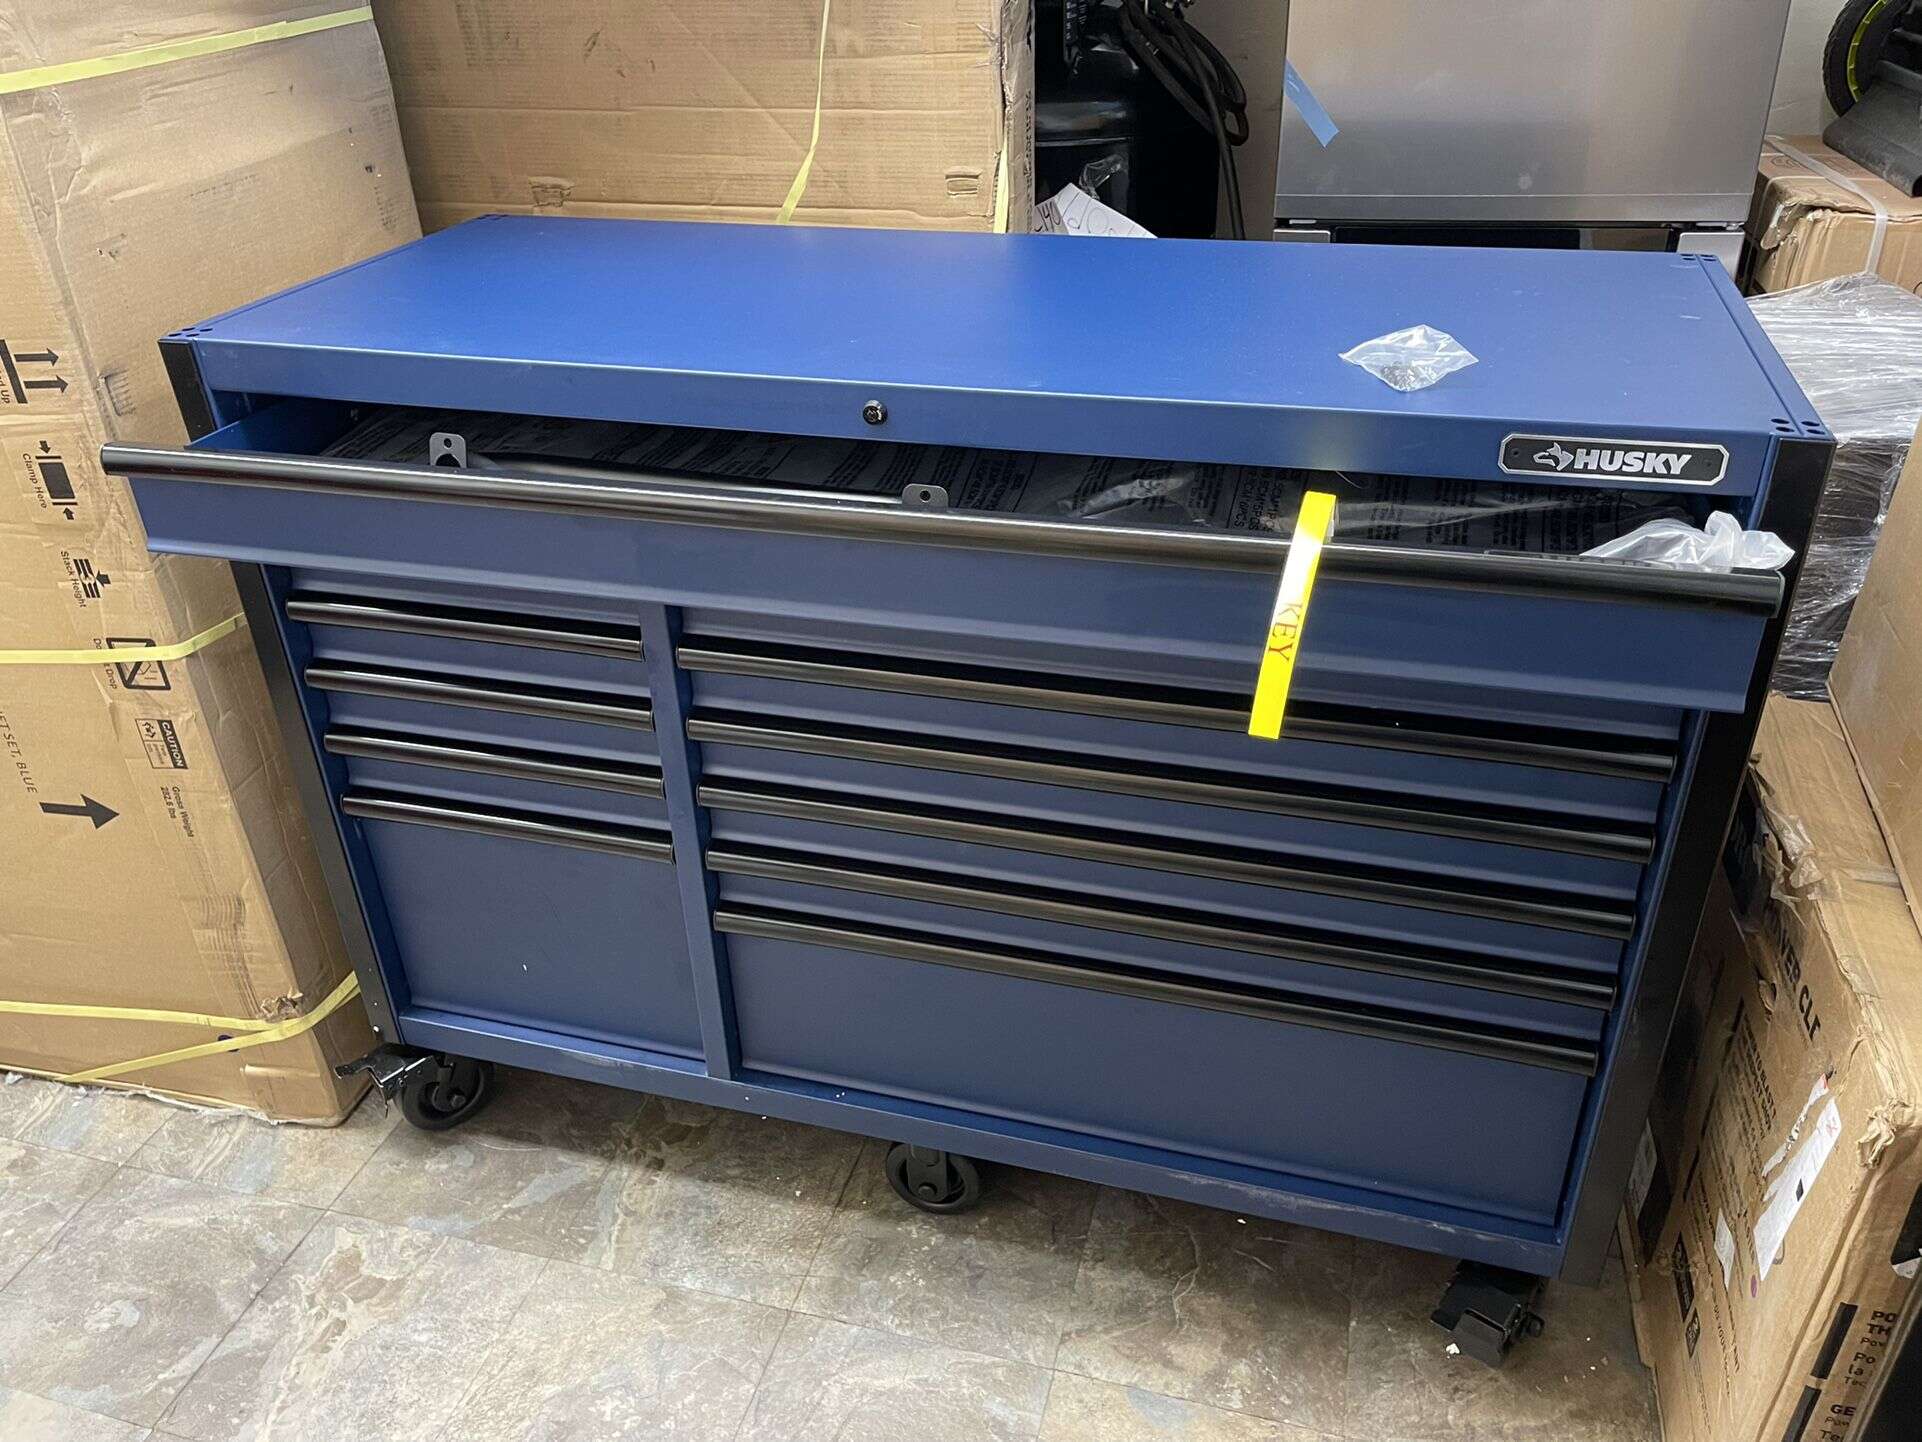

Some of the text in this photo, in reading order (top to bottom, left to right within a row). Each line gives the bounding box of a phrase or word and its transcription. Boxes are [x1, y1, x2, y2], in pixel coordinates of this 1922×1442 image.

[22, 452, 38, 484] Clamp
[1573, 448, 1692, 475] HUSKY
[60, 551, 87, 608] Stack Height
[1269, 603, 1302, 661] KEY
[161, 721, 185, 768] CAUTION
[16, 761, 39, 793] BLUE
